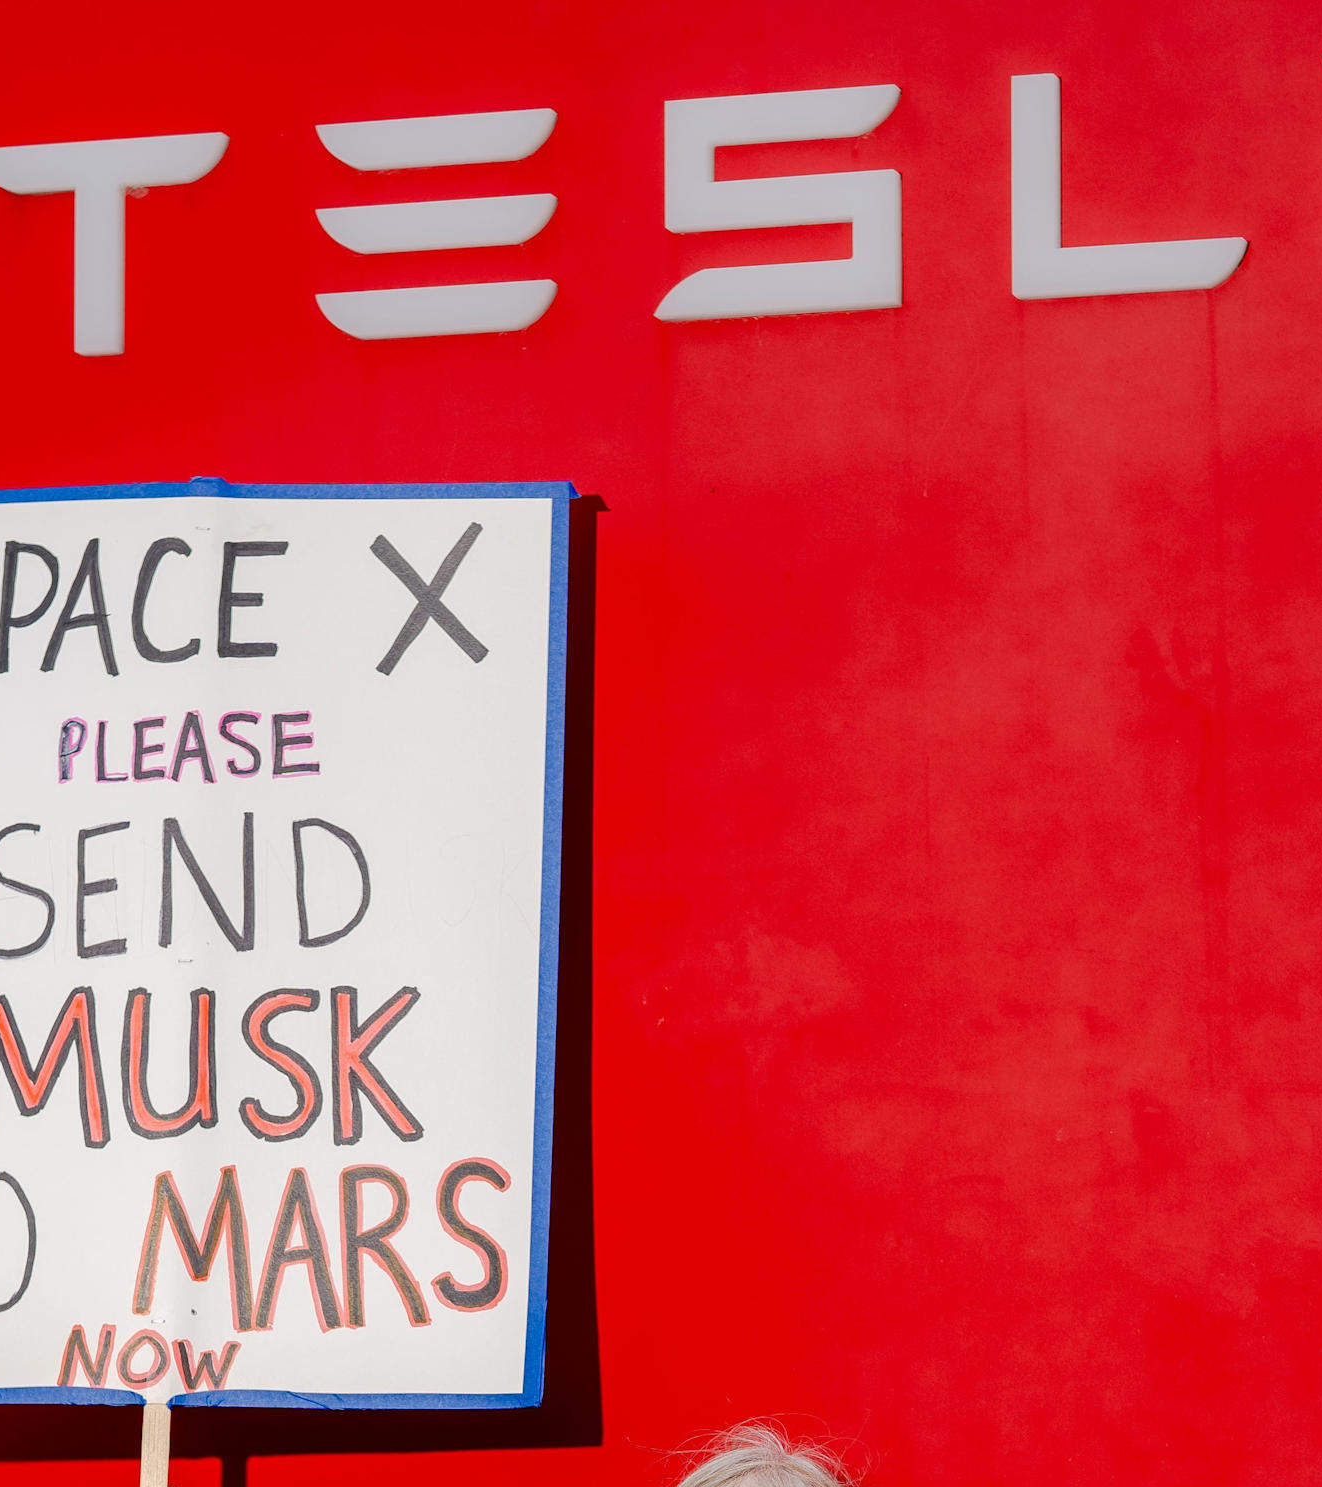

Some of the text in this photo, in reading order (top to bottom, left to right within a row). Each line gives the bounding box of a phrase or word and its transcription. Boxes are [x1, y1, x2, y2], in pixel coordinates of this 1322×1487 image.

[369, 521, 490, 676] X
[57, 709, 321, 784] PLEASE
[131, 1156, 511, 1332] MARS
[56, 1322, 242, 1392] NOW
